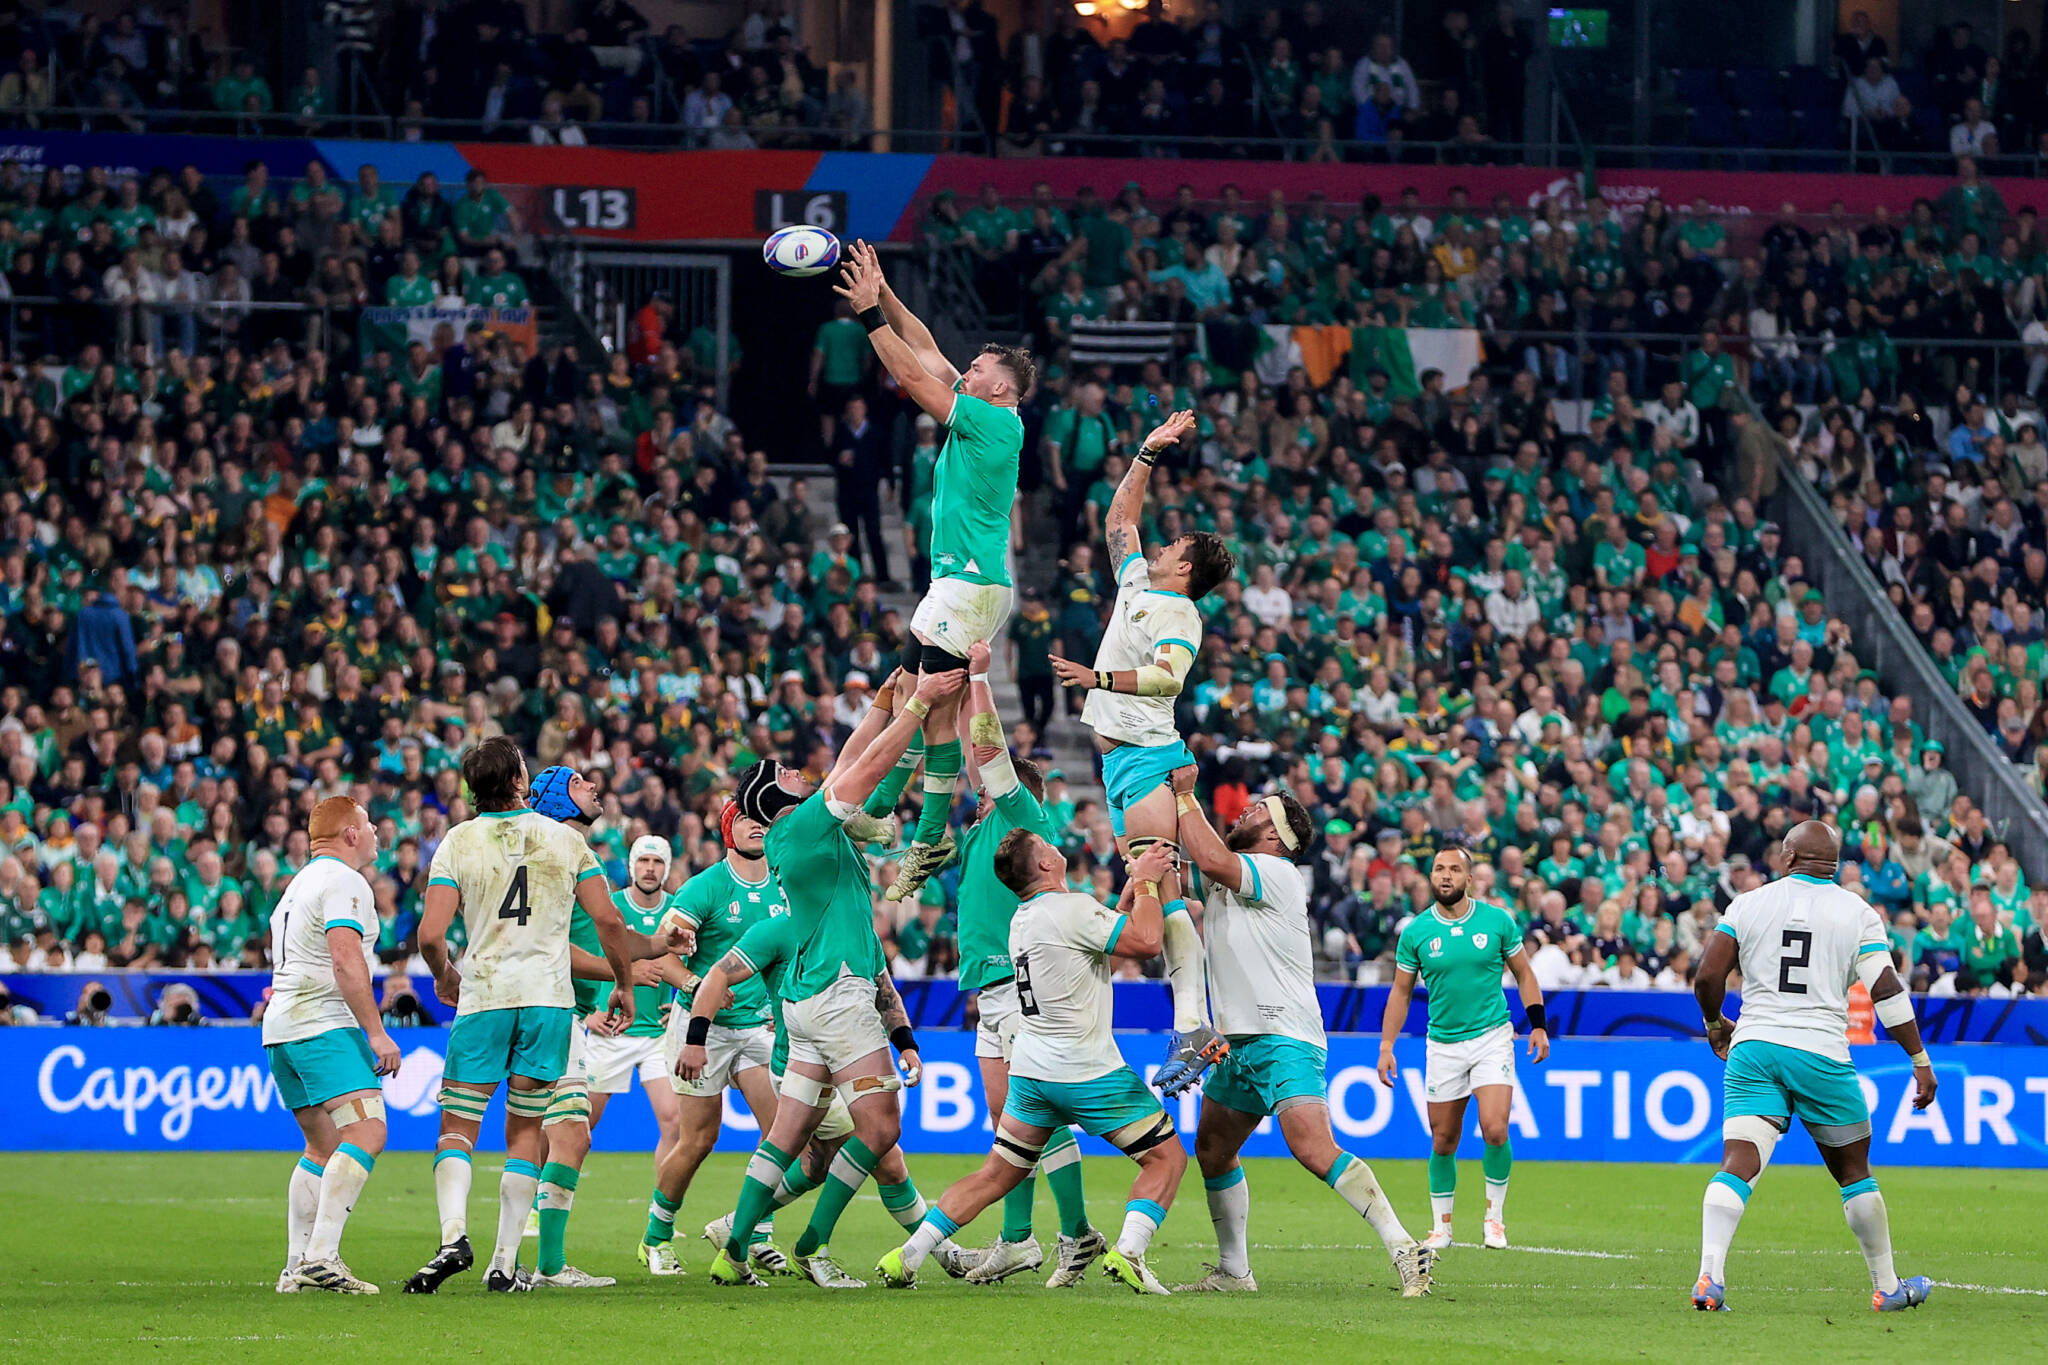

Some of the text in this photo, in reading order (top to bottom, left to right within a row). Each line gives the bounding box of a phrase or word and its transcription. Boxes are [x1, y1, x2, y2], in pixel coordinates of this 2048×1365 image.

[498, 866, 532, 926] 4
[1778, 930, 1812, 994] 2
[38, 1045, 289, 1141] Capgem
